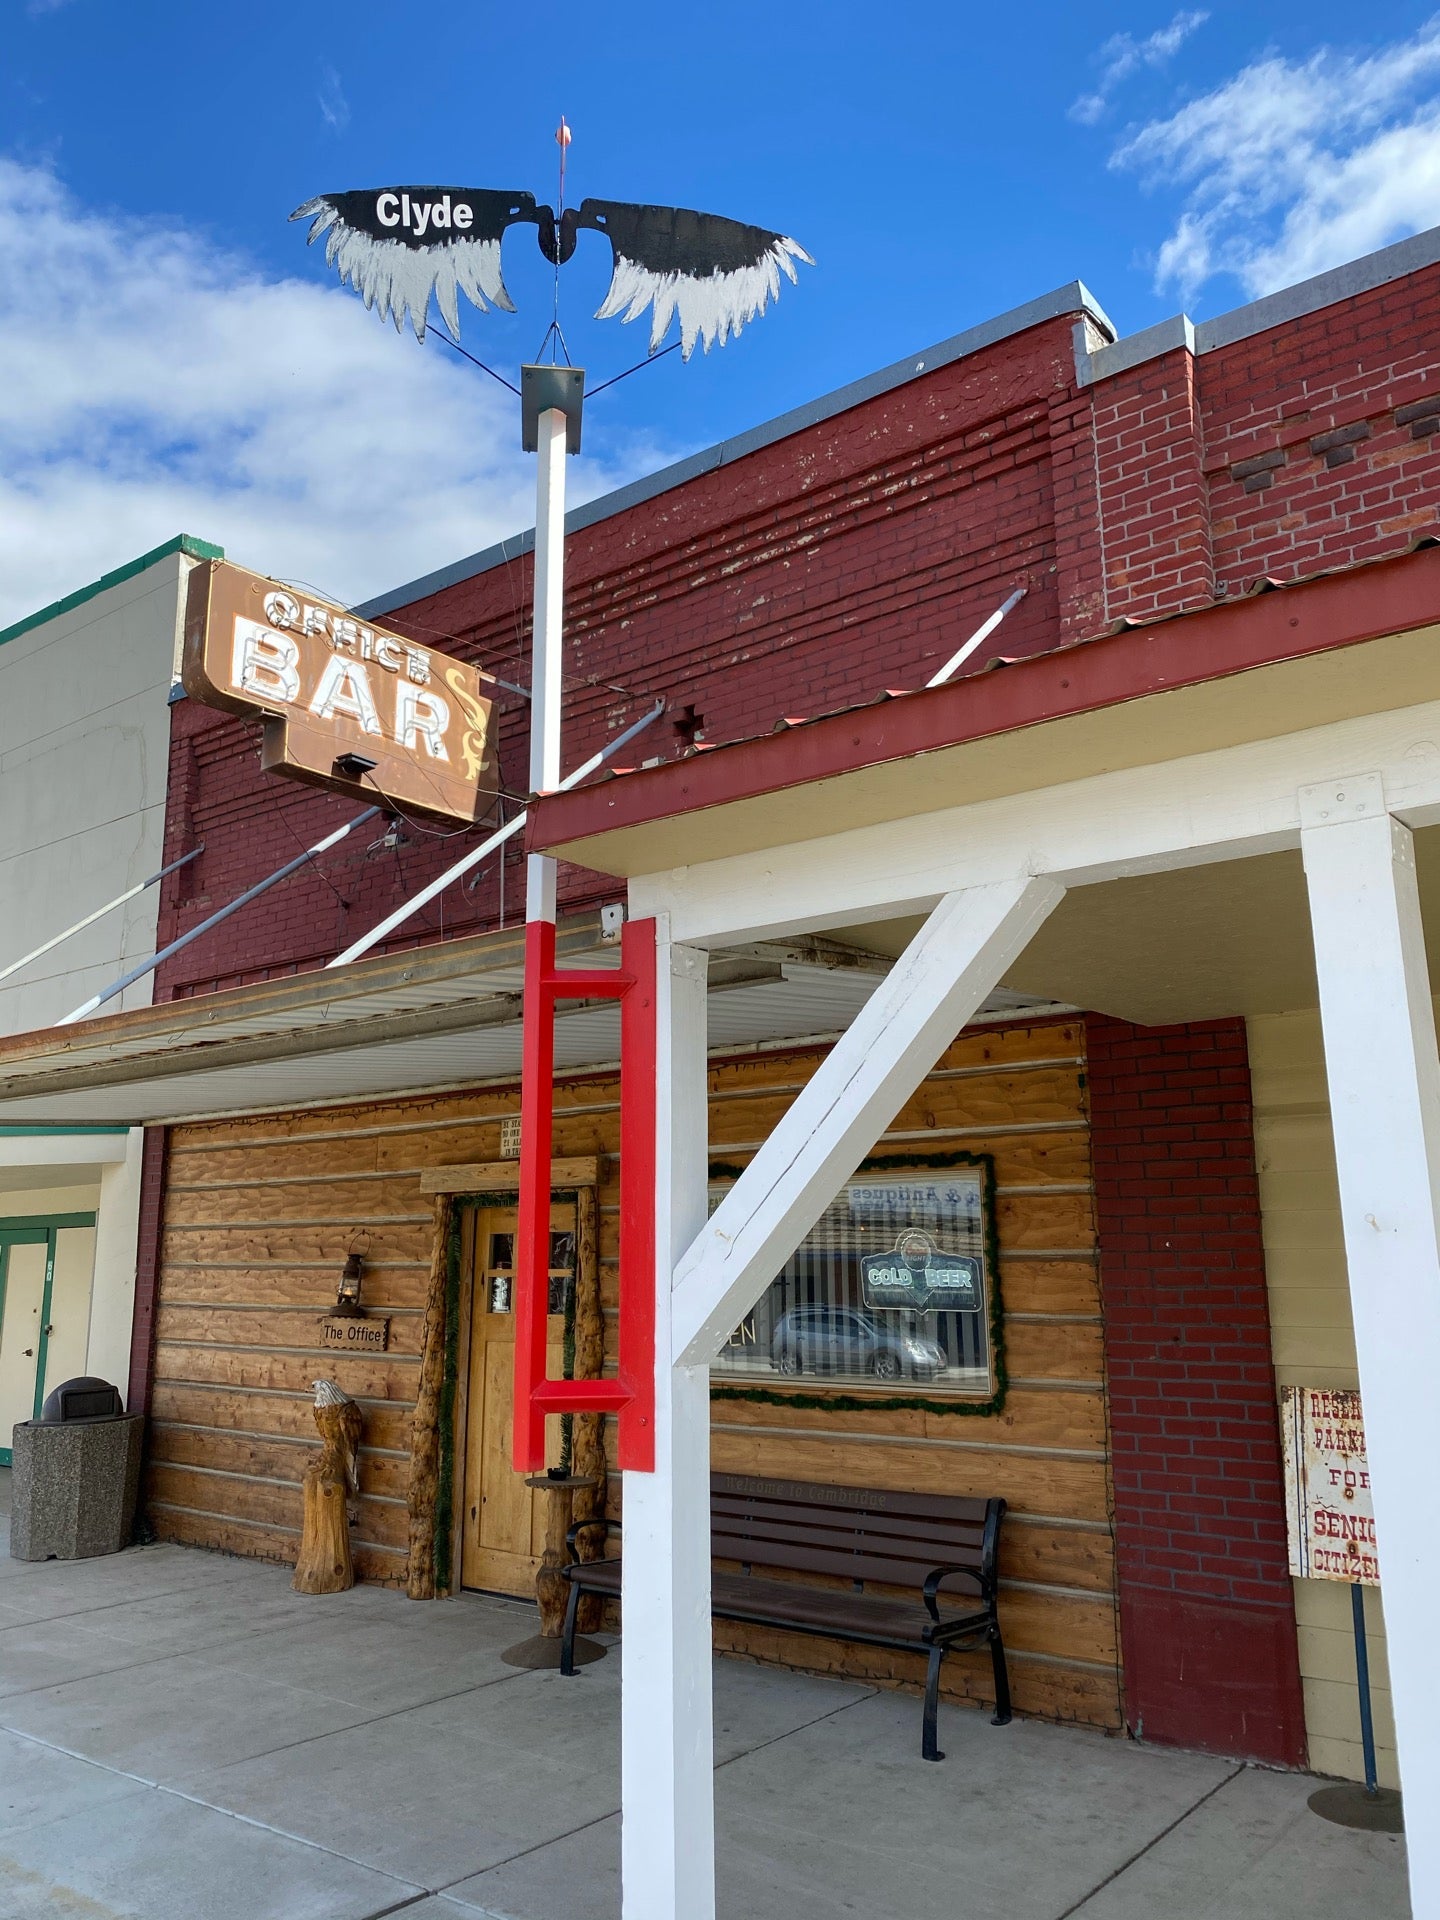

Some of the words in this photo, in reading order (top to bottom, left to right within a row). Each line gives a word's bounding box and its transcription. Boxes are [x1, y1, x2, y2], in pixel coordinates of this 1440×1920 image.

[376, 193, 474, 236] Clyde
[263, 591, 432, 685] OFFICE
[231, 615, 450, 763] BAR
[868, 1267, 912, 1286] COLD
[925, 1268, 972, 1288] BEER
[324, 1325, 343, 1340] The
[347, 1326, 381, 1342] Office
[1311, 1393, 1363, 1420] RESER
[1315, 1427, 1366, 1452] PARKI
[726, 1476, 785, 1496] Welcome
[1314, 1510, 1377, 1544] SENIO
[1313, 1549, 1380, 1579] CITIZE
